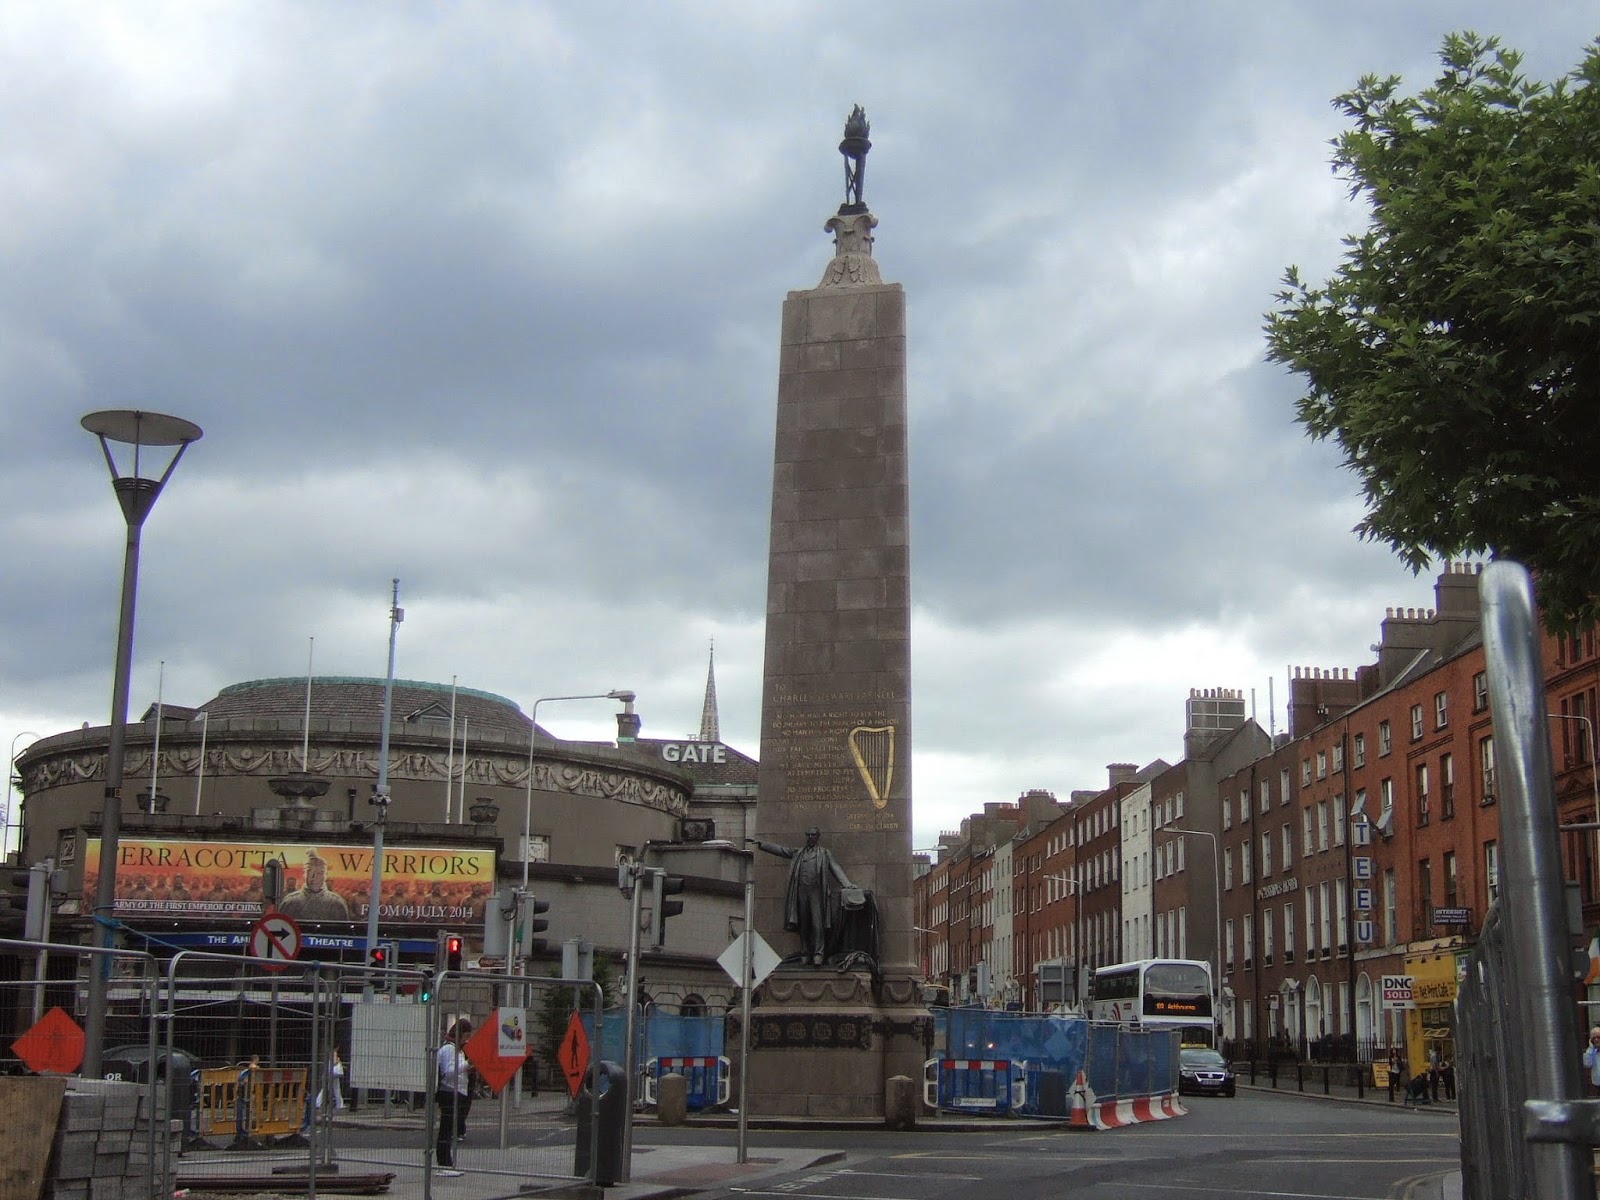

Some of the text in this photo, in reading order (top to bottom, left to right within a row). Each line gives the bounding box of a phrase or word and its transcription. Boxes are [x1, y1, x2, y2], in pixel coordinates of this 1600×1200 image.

[662, 743, 726, 763] GATE
[117, 846, 289, 869] ERRACOTTA
[114, 901, 136, 909] ARMY
[137, 901, 148, 909] OF
[165, 902, 186, 910] FIRST
[187, 903, 224, 911] EMPEROR
[225, 903, 236, 911] OF
[237, 904, 262, 912] CHINA
[361, 903, 473, 918] FOM 04 JULY 2014
[208, 935, 227, 944] THE
[309, 937, 354, 947] THEATRE
[1384, 978, 1412, 989] DNC
[1386, 990, 1411, 999] SOLD
